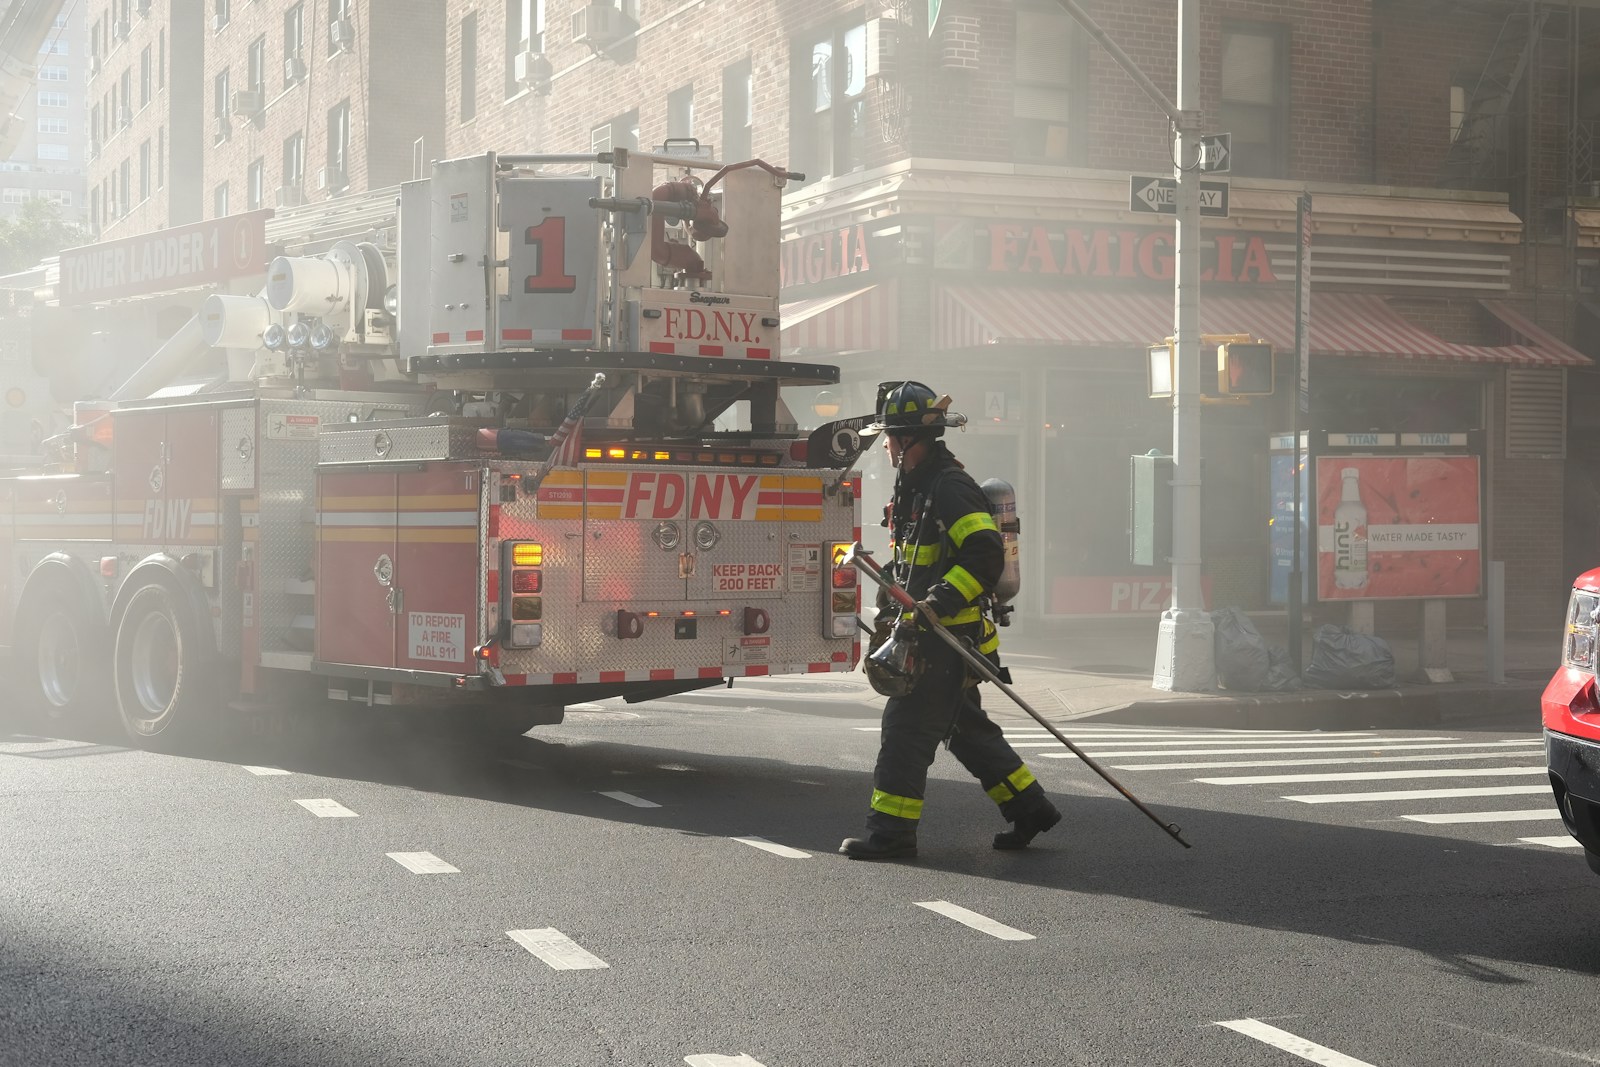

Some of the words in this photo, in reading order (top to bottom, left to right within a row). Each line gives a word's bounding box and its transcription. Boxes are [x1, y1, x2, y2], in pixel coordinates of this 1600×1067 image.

[1146, 188, 1174, 203] ONE
[1200, 191, 1217, 206] AY
[65, 246, 126, 295] TOWER
[129, 231, 205, 284] LADDER
[209, 227, 219, 270] 1
[525, 216, 577, 294] 1
[663, 307, 761, 344] F.D.N.Y.
[988, 395, 1002, 411] A
[1280, 437, 1295, 449] TITA
[1345, 434, 1379, 445] TITAN
[1417, 433, 1450, 445] TITAN
[624, 472, 759, 520] FDNY
[143, 499, 192, 540] FDNY
[1371, 533, 1402, 542] WATER
[1405, 532, 1433, 542] MADE
[1335, 521, 1350, 570] hint
[713, 564, 746, 577] KEEP
[748, 564, 782, 577] BACK
[719, 578, 744, 590] 200
[747, 577, 776, 590] FEET
[411, 614, 423, 626] TO
[425, 615, 463, 629] REPORT
[422, 630, 429, 642] A
[431, 630, 451, 644] FIRE
[416, 645, 437, 658] DIAL
[439, 646, 456, 659] 911
